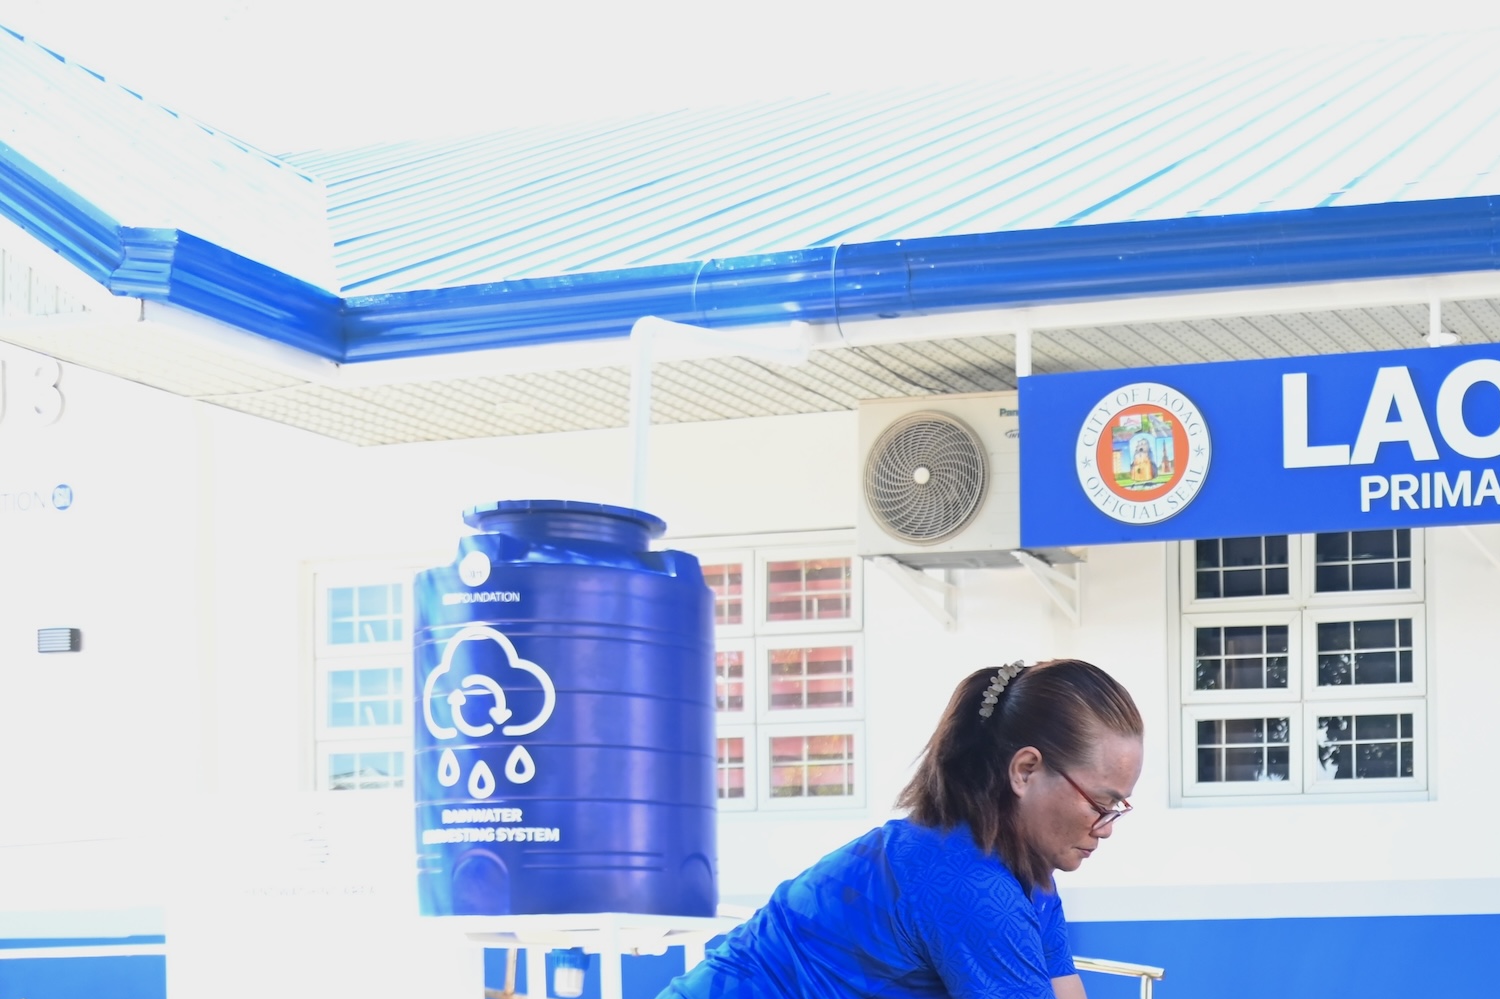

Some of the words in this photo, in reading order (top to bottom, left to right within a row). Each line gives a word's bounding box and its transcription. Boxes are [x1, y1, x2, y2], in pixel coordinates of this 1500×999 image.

[1083, 402, 1112, 447] CITY
[1116, 387, 1140, 407] OF
[1147, 387, 1203, 437] LAOAG
[1086, 476, 1164, 519] OFFICIAL
[1167, 466, 1204, 510] SEAL
[496, 827, 560, 842] SYSTEM
